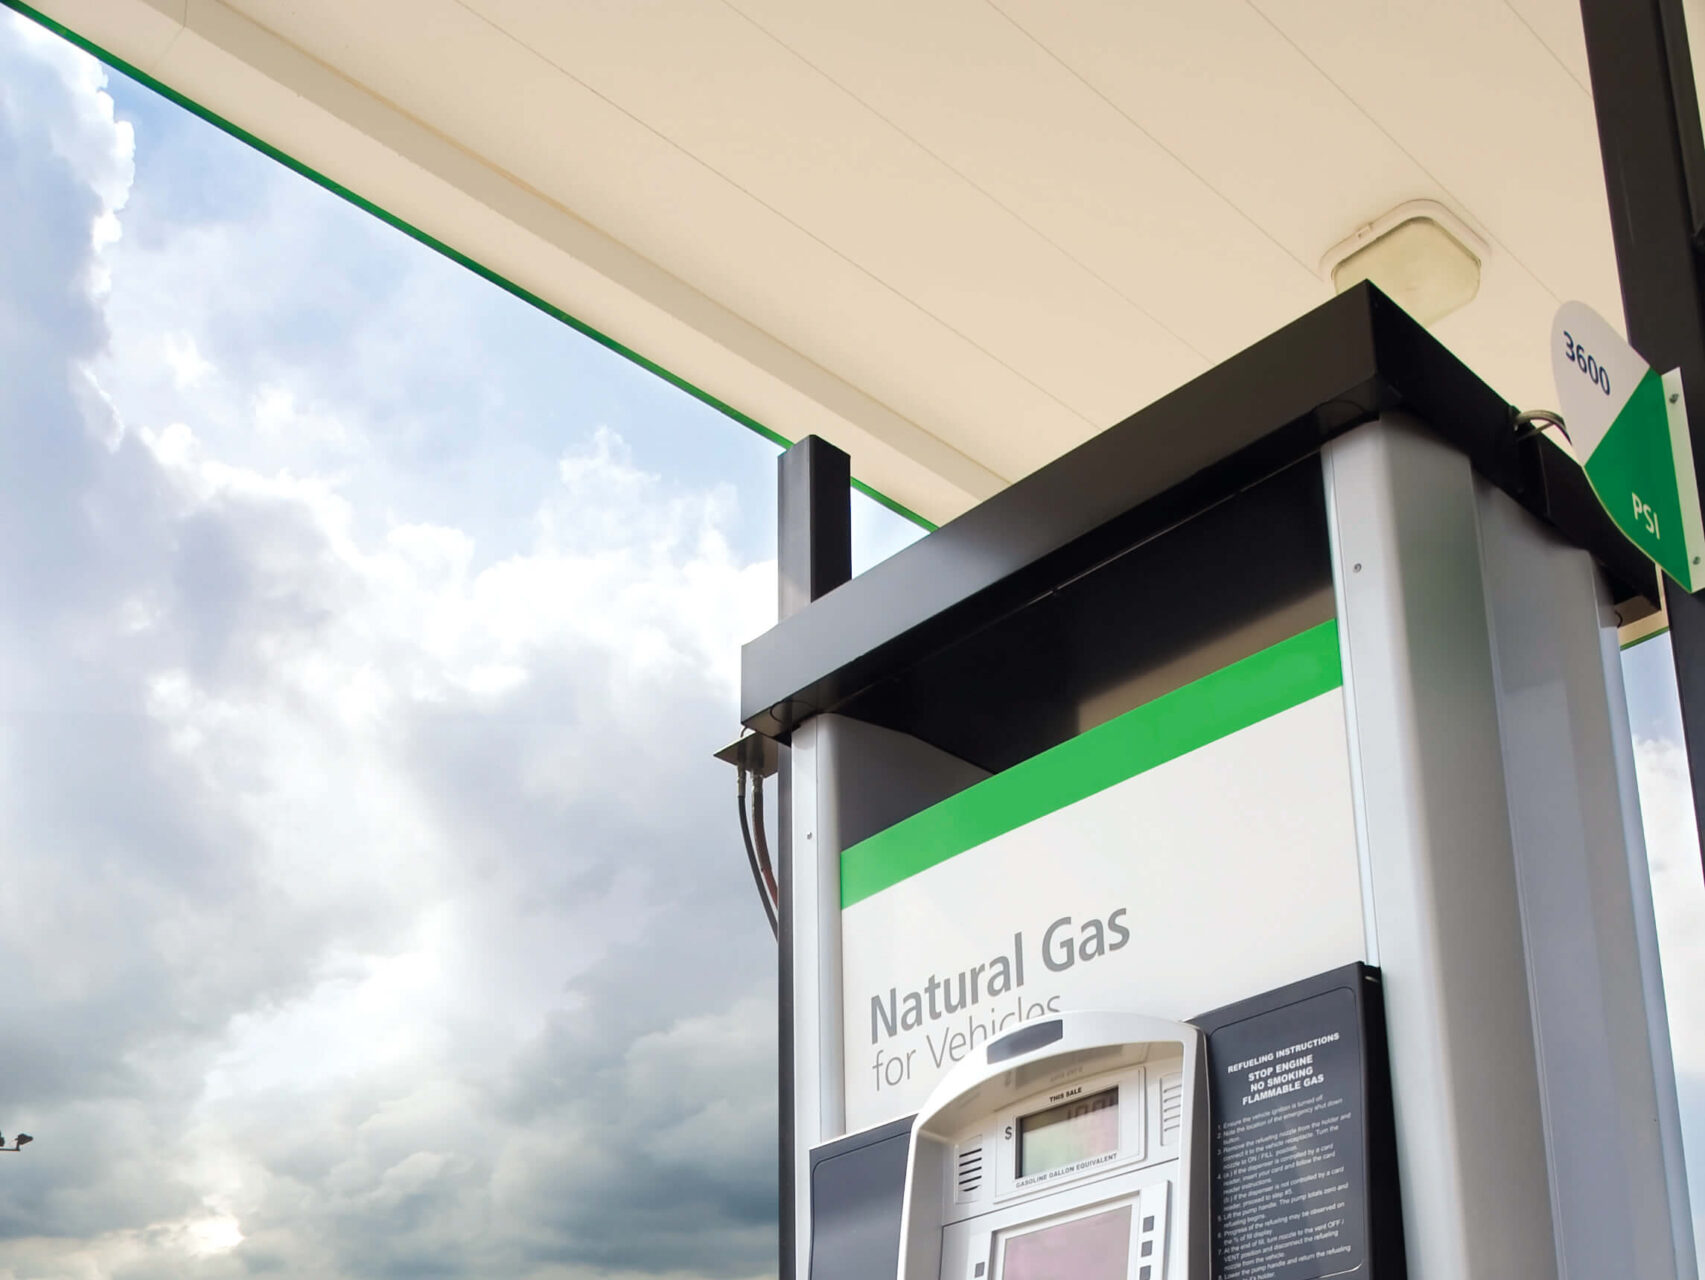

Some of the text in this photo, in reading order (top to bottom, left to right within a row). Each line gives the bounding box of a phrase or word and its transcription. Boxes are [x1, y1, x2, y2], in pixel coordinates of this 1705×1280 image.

[1563, 330, 1610, 396] 3600
[1632, 492, 1660, 540] PSI
[871, 908, 1130, 1044] Natural Gas
[872, 1048, 916, 1091] for
[1228, 1032, 1340, 1073] REFUELING INSTRUCTIONS
[1248, 1055, 1313, 1082] STOP ENGINE
[1049, 1087, 1082, 1103] THIS SALE
[1242, 1074, 1324, 1106] FLAMMABLE GAS
[1250, 1066, 1313, 1092] NO SMOKING
[1004, 1126, 1012, 1140] $
[1016, 1153, 1117, 1188] GASOLINE GALLON EQUIVALENT
